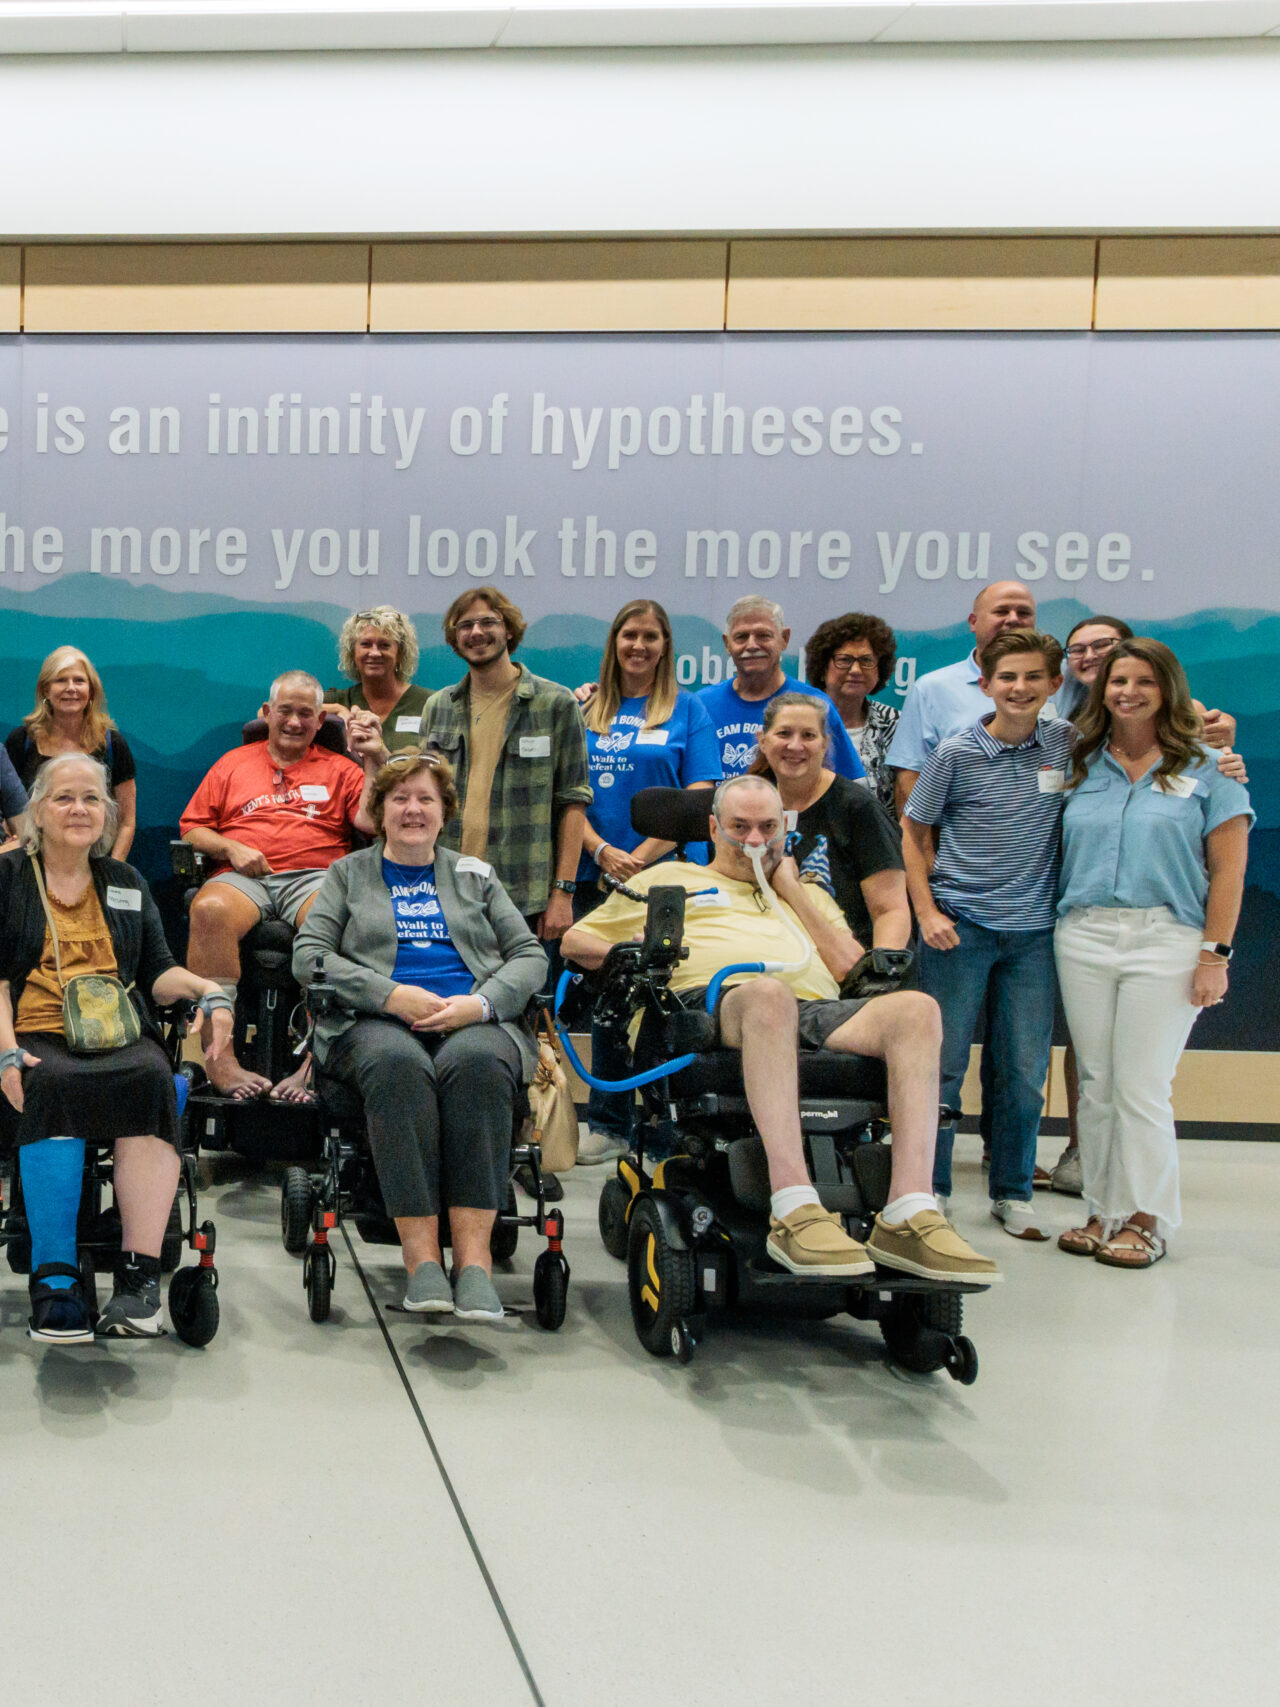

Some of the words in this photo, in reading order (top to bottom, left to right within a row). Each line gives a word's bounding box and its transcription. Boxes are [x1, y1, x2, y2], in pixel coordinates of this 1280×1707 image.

[36, 392, 86, 454] is
[108, 405, 181, 454] an
[208, 392, 426, 468] infinity
[450, 392, 510, 455] of
[531, 392, 924, 469] hypotheses.
[90, 525, 248, 576] more
[271, 527, 380, 589] you
[407, 514, 537, 577] look
[558, 515, 658, 578] the
[685, 527, 852, 579] more
[876, 529, 991, 594] you
[1015, 529, 1155, 582] see.
[716, 723, 741, 739] EAM
[591, 754, 615, 763] Walk
[588, 762, 614, 771] efeat
[615, 763, 635, 771] ALS
[396, 920, 429, 930] Walk
[430, 921, 444, 930] to
[397, 929, 429, 938] efeat
[800, 1110, 839, 1119] permobil
